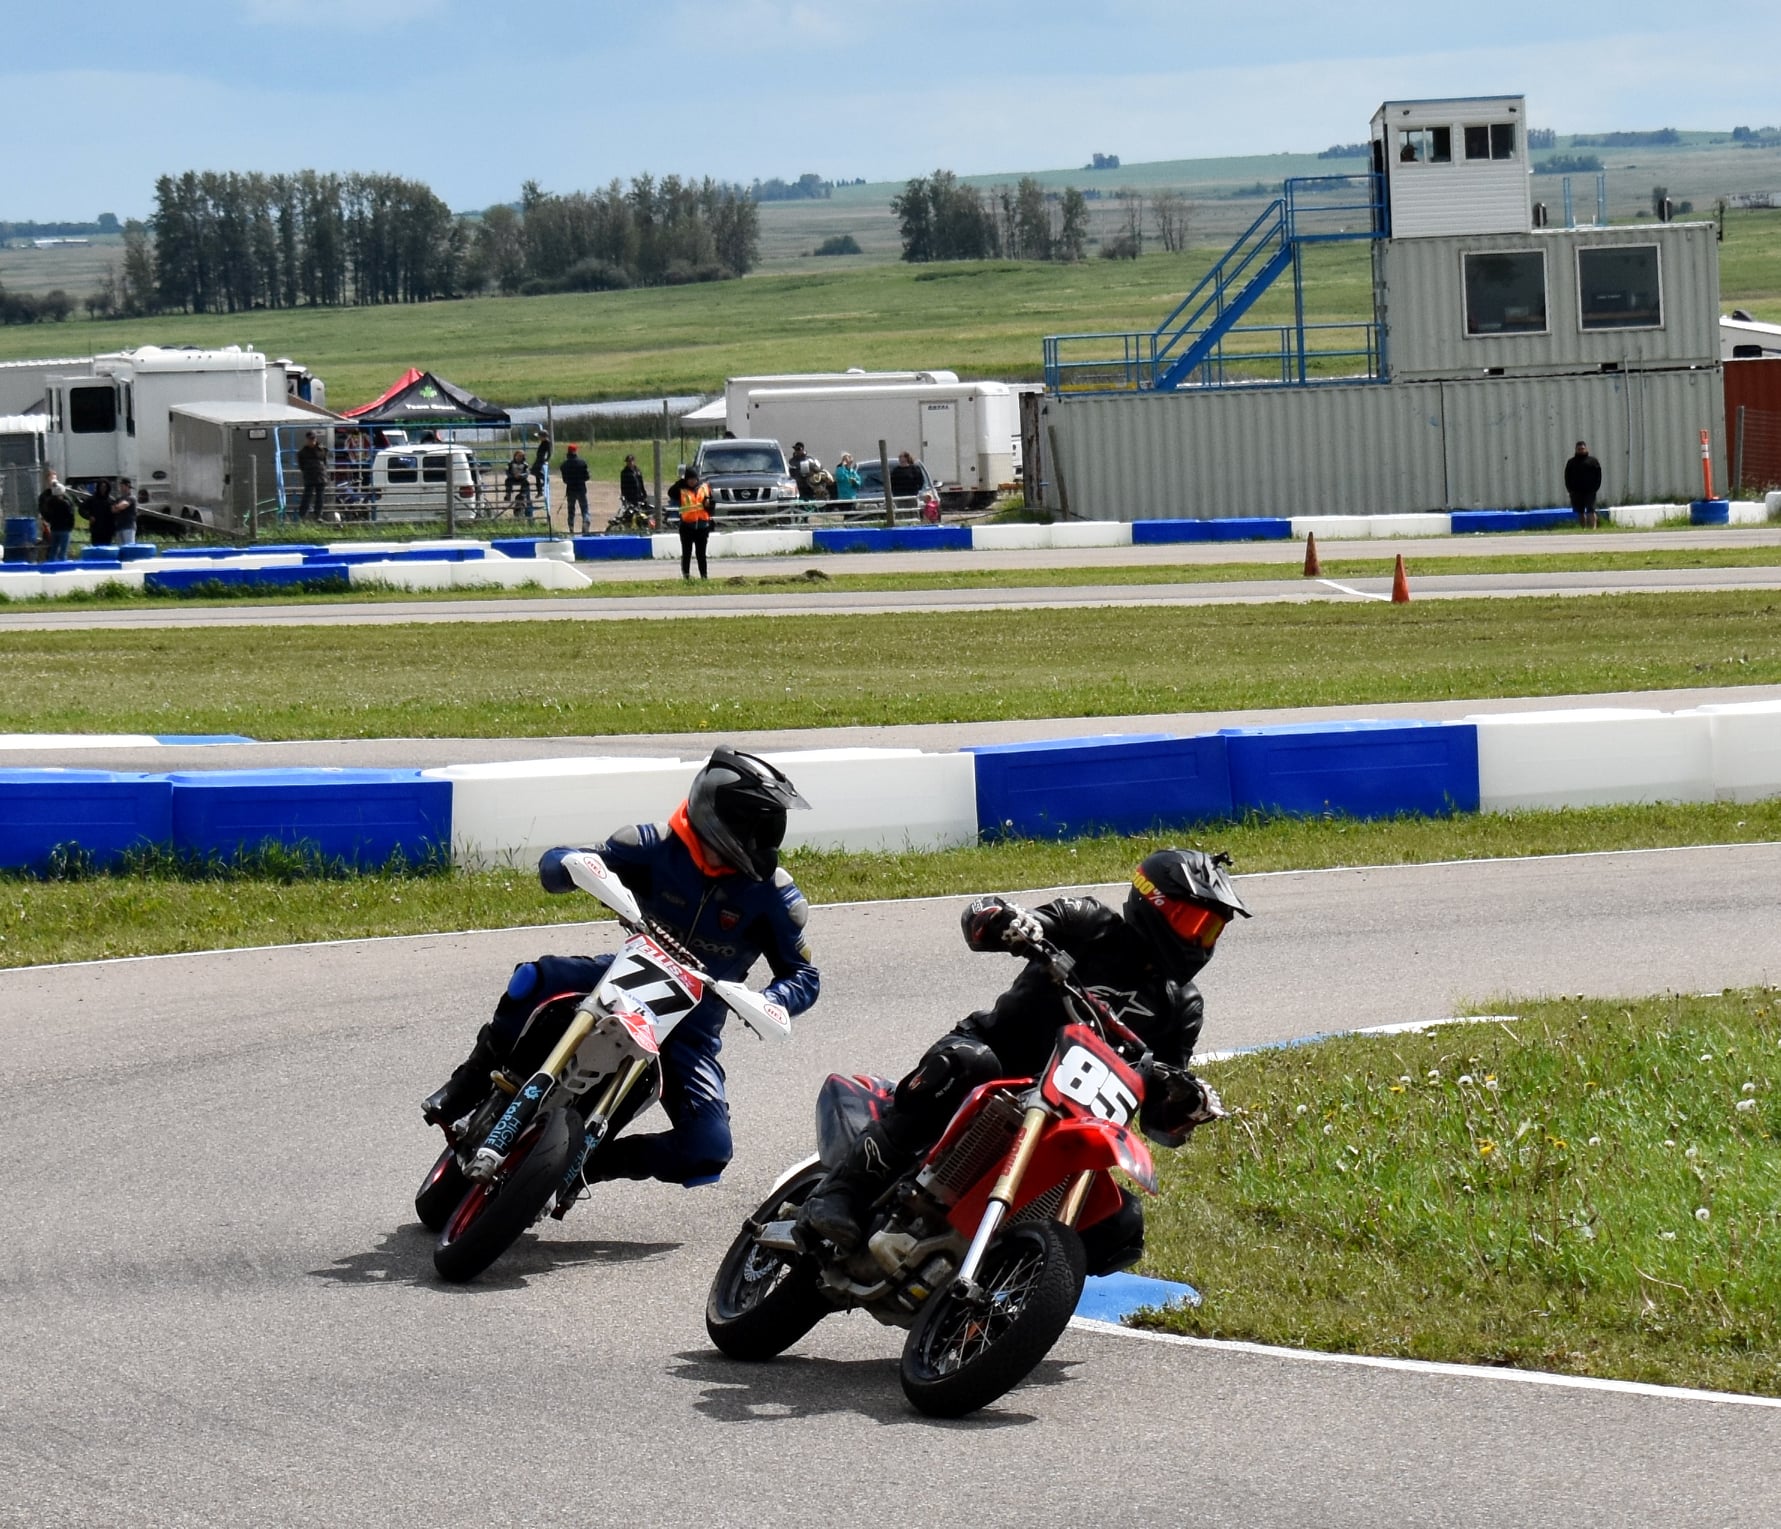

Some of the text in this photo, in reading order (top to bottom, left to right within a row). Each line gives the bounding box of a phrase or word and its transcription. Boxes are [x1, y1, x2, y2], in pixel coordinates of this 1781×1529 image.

[1132, 872, 1166, 906] 100%
[639, 943, 683, 977] ELLIS
[610, 953, 697, 1017] 77
[1052, 1045, 1138, 1127] 85
[484, 1101, 521, 1146] TORQUE
[494, 1115, 523, 1152] HIGH
